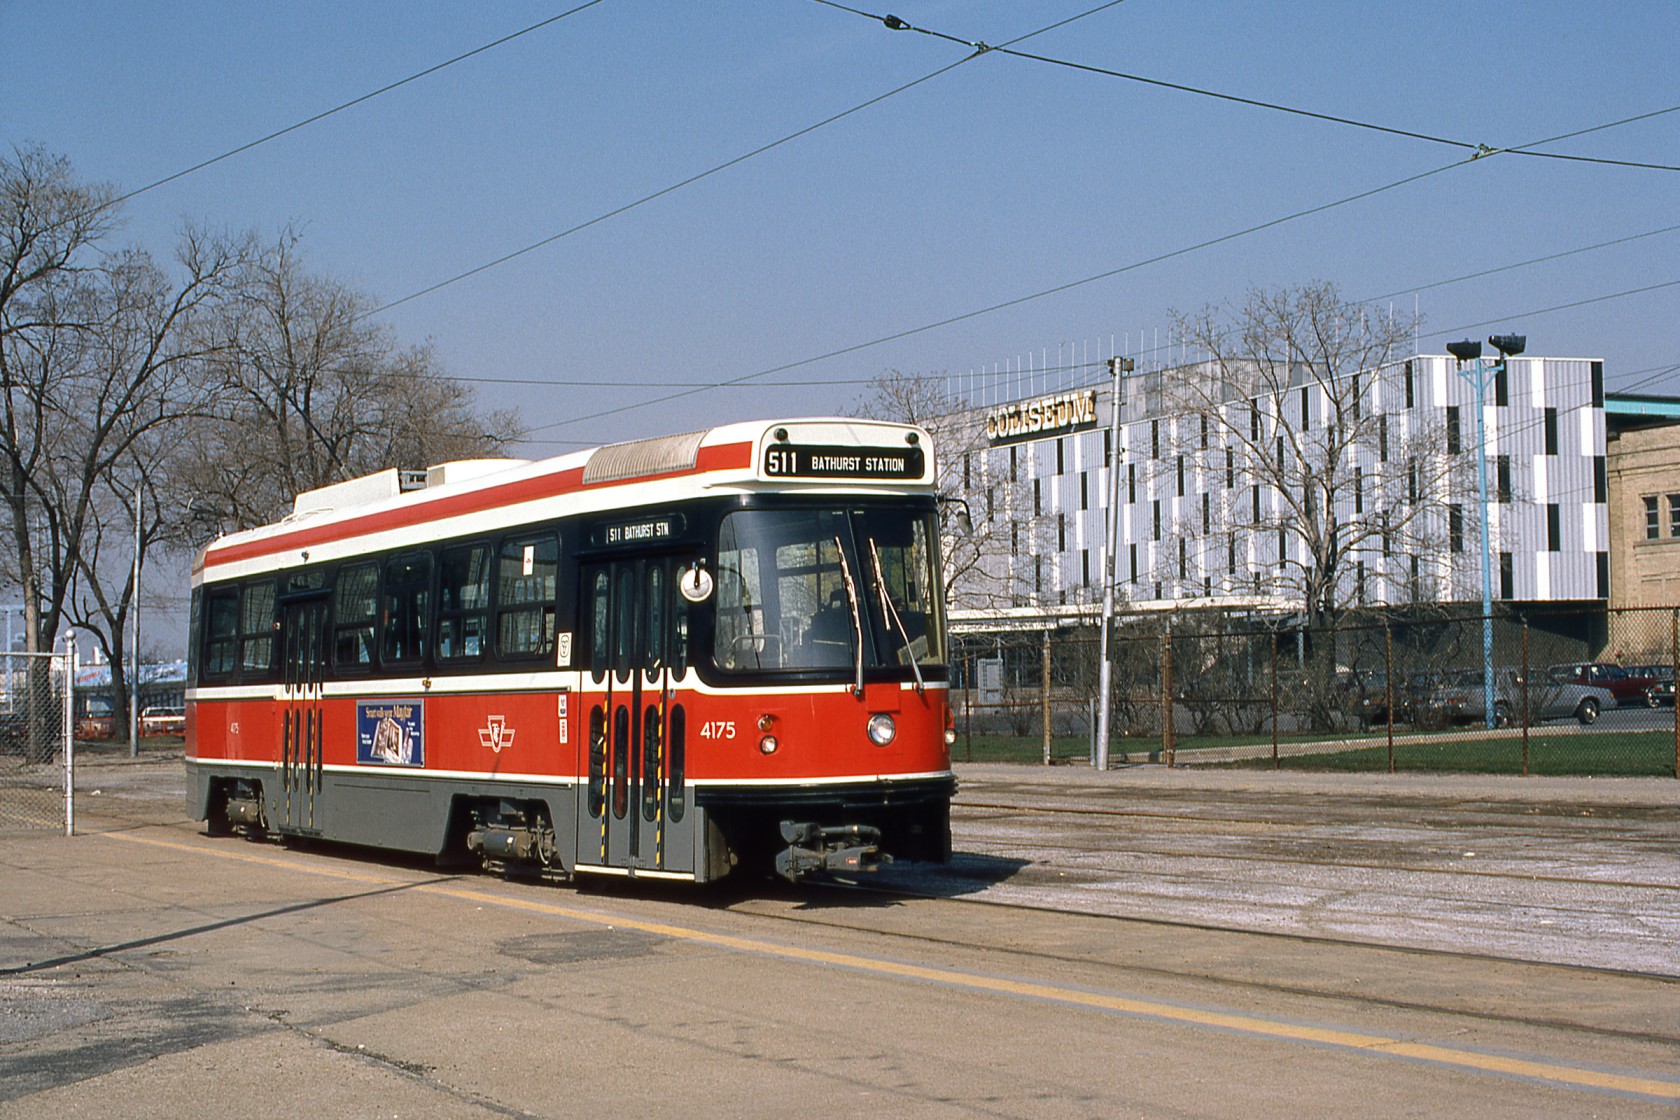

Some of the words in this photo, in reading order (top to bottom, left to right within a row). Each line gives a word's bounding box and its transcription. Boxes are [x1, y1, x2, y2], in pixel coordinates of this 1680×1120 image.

[986, 390, 1095, 440] COLISEUM
[768, 451, 797, 473] 511
[811, 456, 861, 472] BATHURST
[865, 457, 905, 473] STATION
[609, 527, 621, 542] 511
[624, 523, 654, 540] BATHURST
[656, 522, 669, 537] STN
[700, 721, 736, 739] 4175
